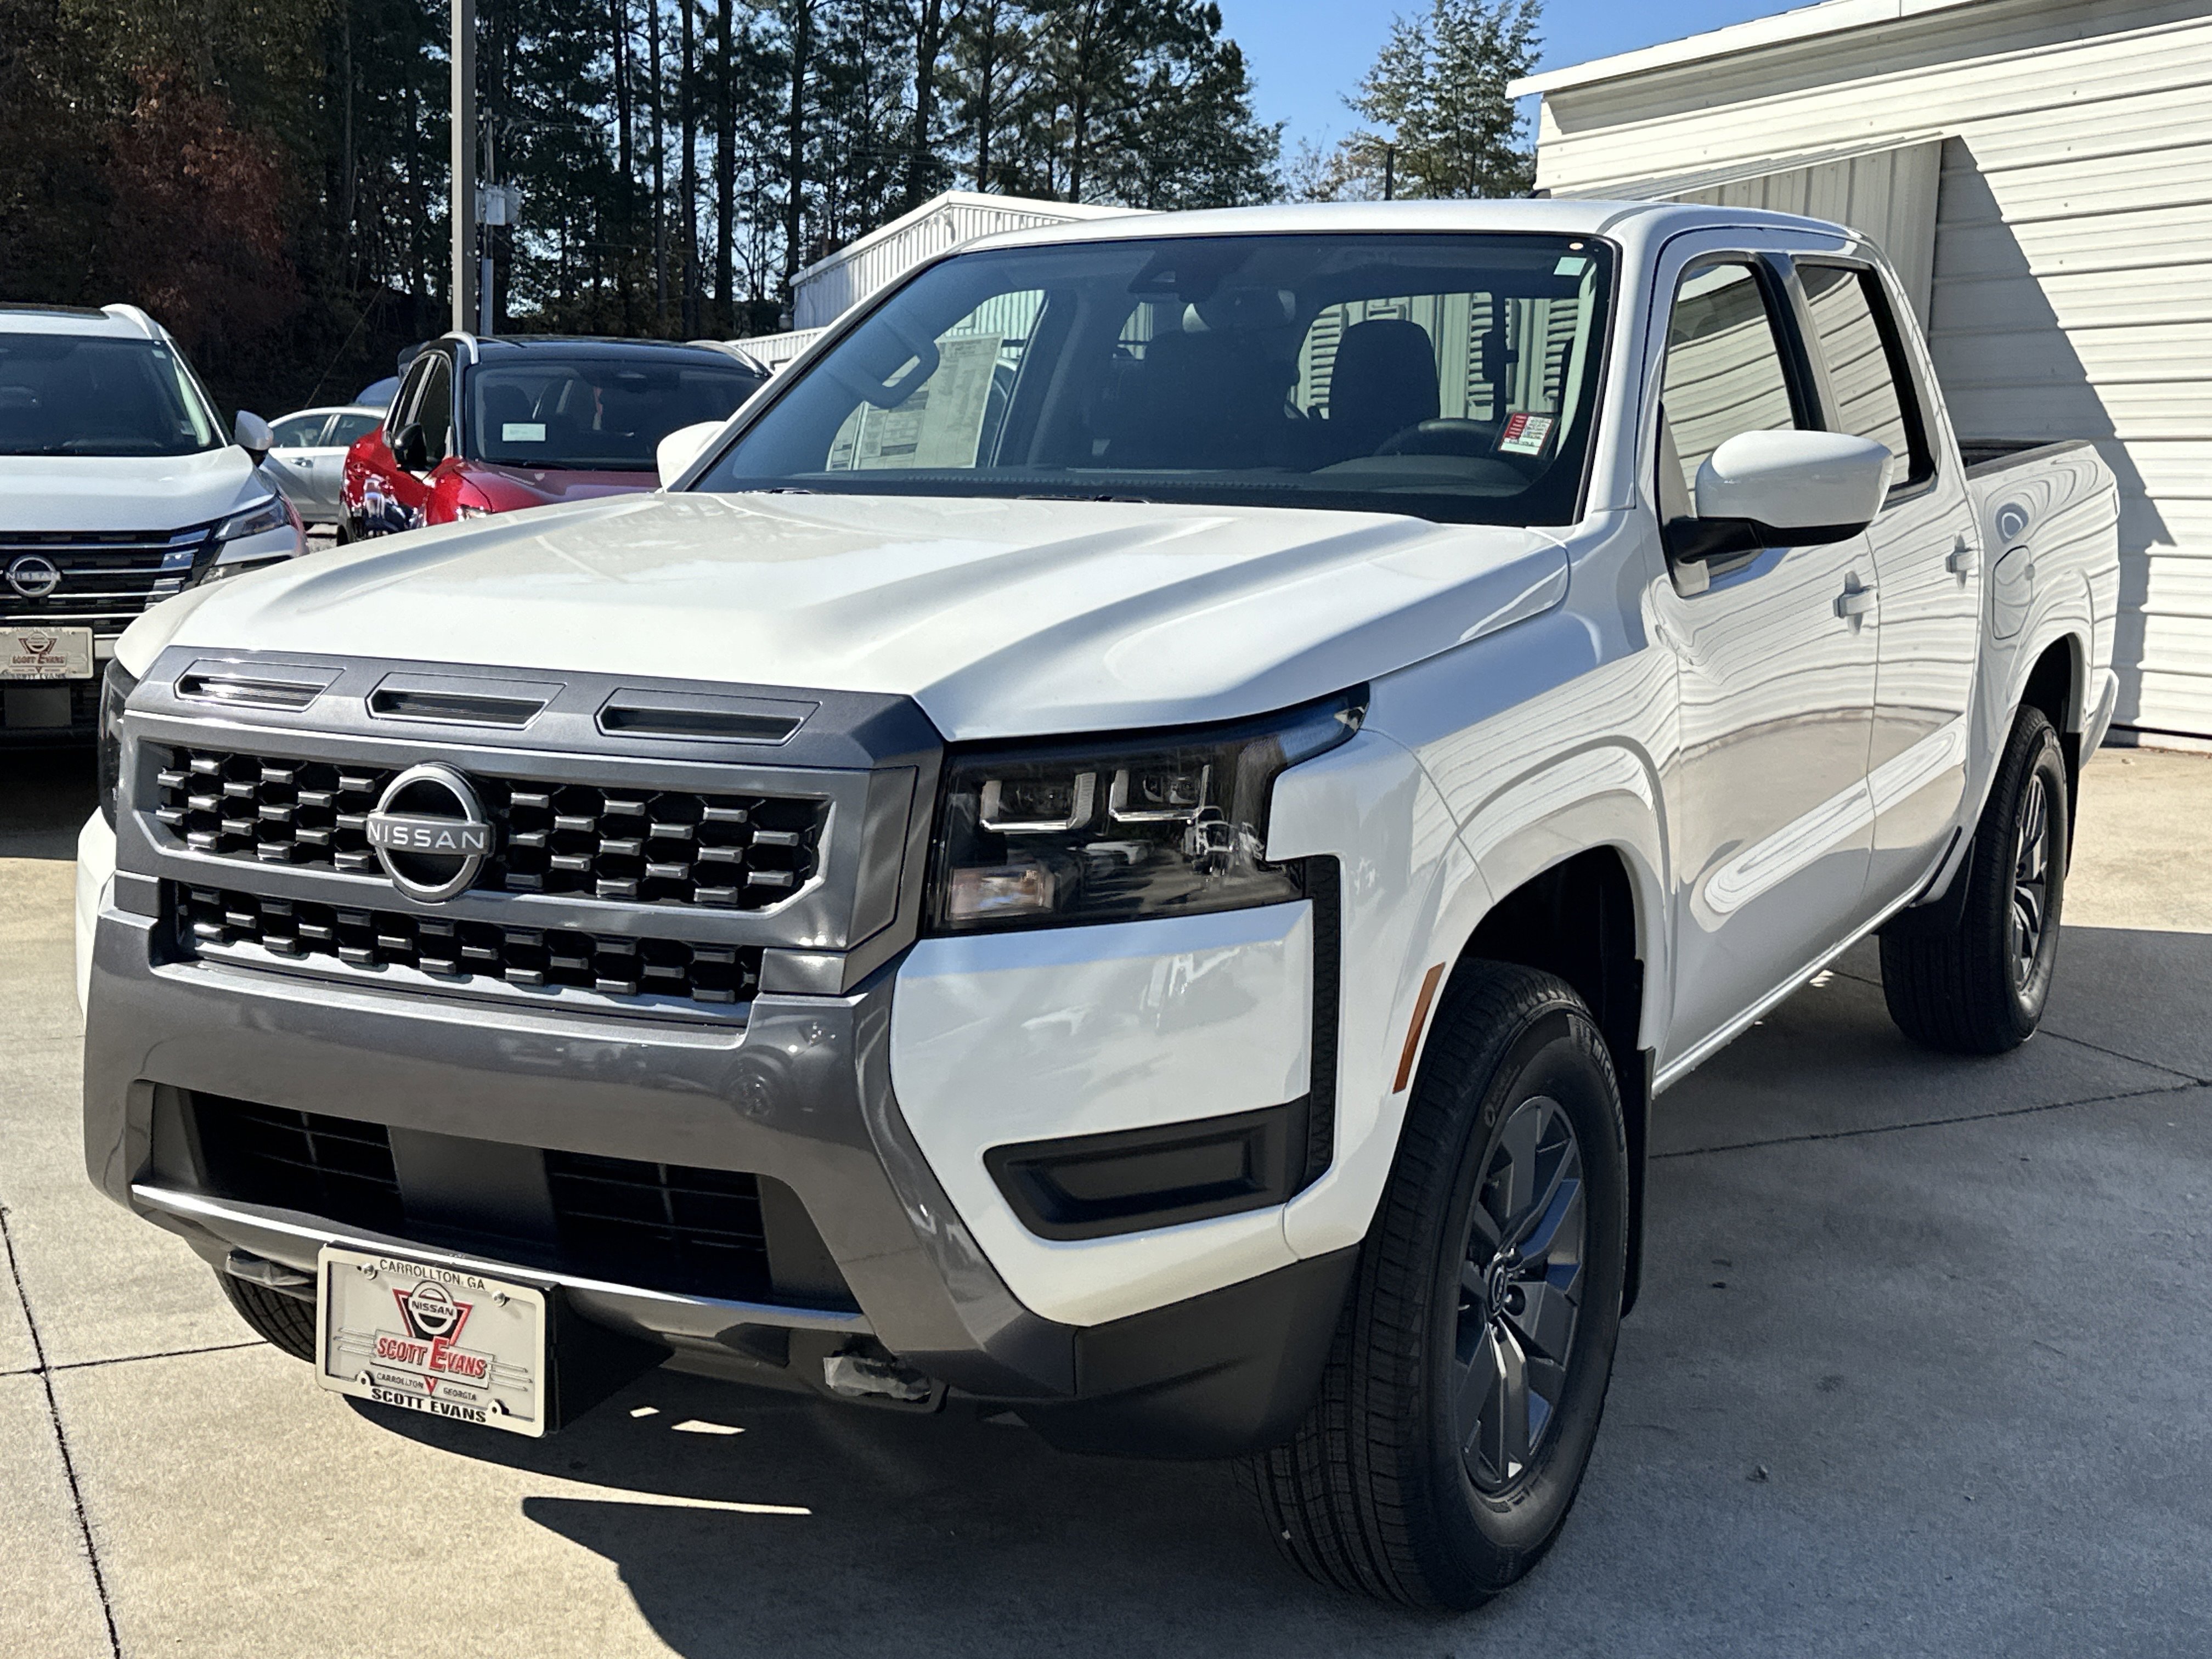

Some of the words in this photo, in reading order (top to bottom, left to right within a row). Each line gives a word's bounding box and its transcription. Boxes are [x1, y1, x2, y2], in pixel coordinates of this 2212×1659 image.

[5, 572, 60, 580] NISSAN
[368, 821, 484, 849] NISSAN
[467, 1277, 486, 1290] GA
[411, 1300, 454, 1316] NISSAN
[377, 1337, 428, 1366] SCOTT
[428, 1336, 488, 1379] EVANS
[377, 1372, 424, 1389] CARROLLTON
[443, 1387, 477, 1401] GEORGIA
[371, 1388, 425, 1409] SCOTT
[430, 1400, 487, 1423] EVANS
